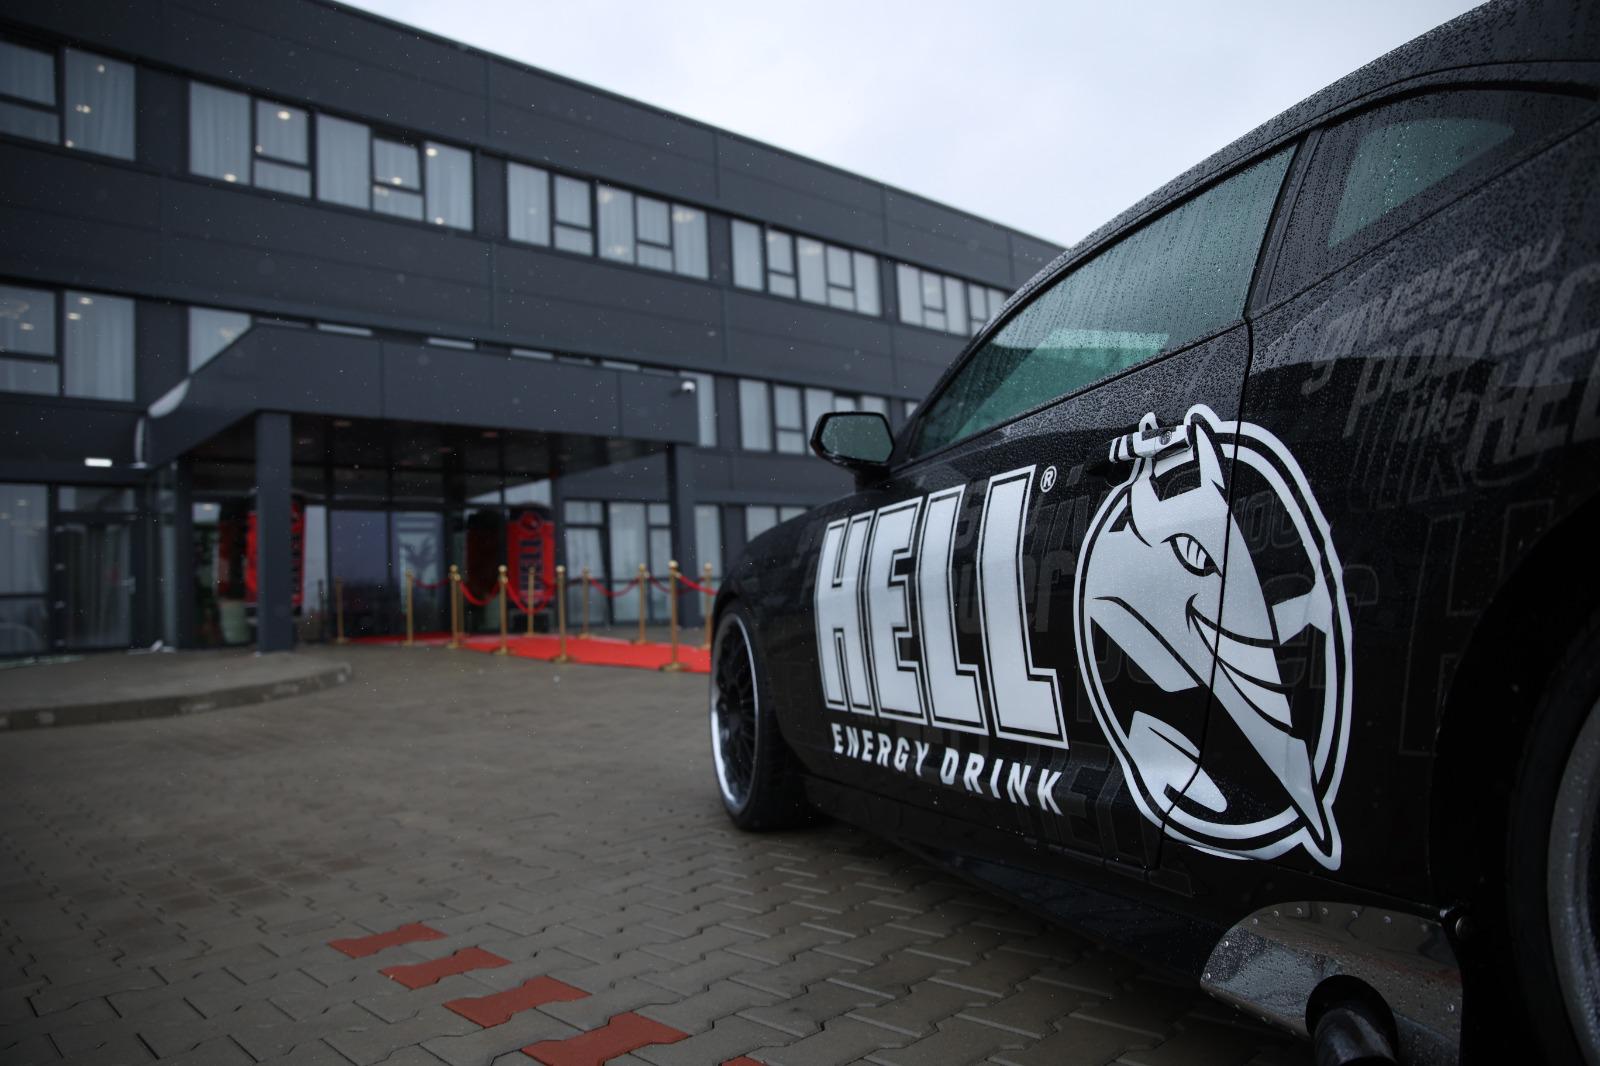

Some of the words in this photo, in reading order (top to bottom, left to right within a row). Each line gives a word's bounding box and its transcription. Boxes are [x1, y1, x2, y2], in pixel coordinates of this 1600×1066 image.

[813, 464, 1069, 750] HELL
[830, 722, 931, 779] ENERGY
[940, 746, 1065, 817] DRINK
